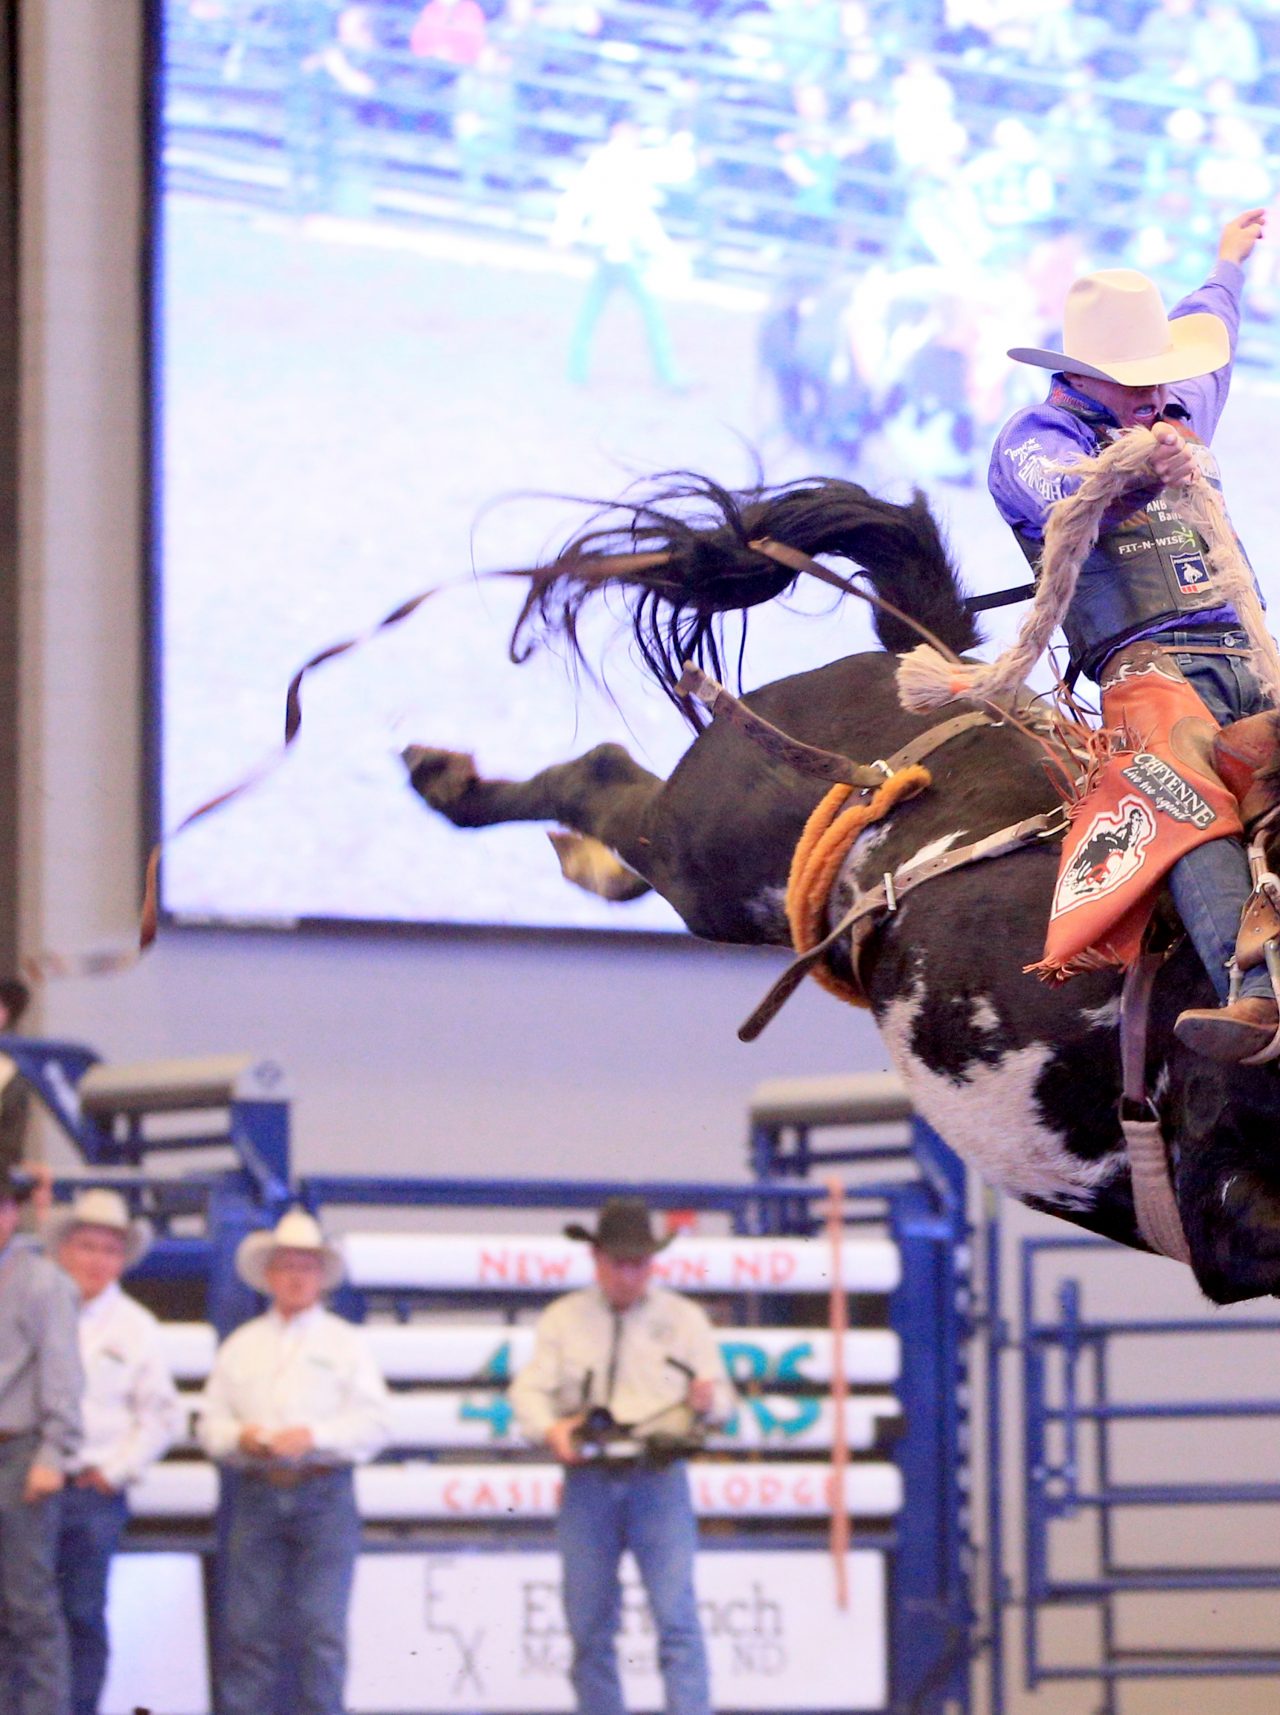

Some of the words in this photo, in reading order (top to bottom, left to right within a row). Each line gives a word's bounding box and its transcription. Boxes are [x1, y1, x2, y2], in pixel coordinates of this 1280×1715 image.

[1118, 535, 1185, 555] FIT-N-WISE
[1134, 753, 1216, 827] CHEYENNE
[442, 1478, 564, 1511] CASI
